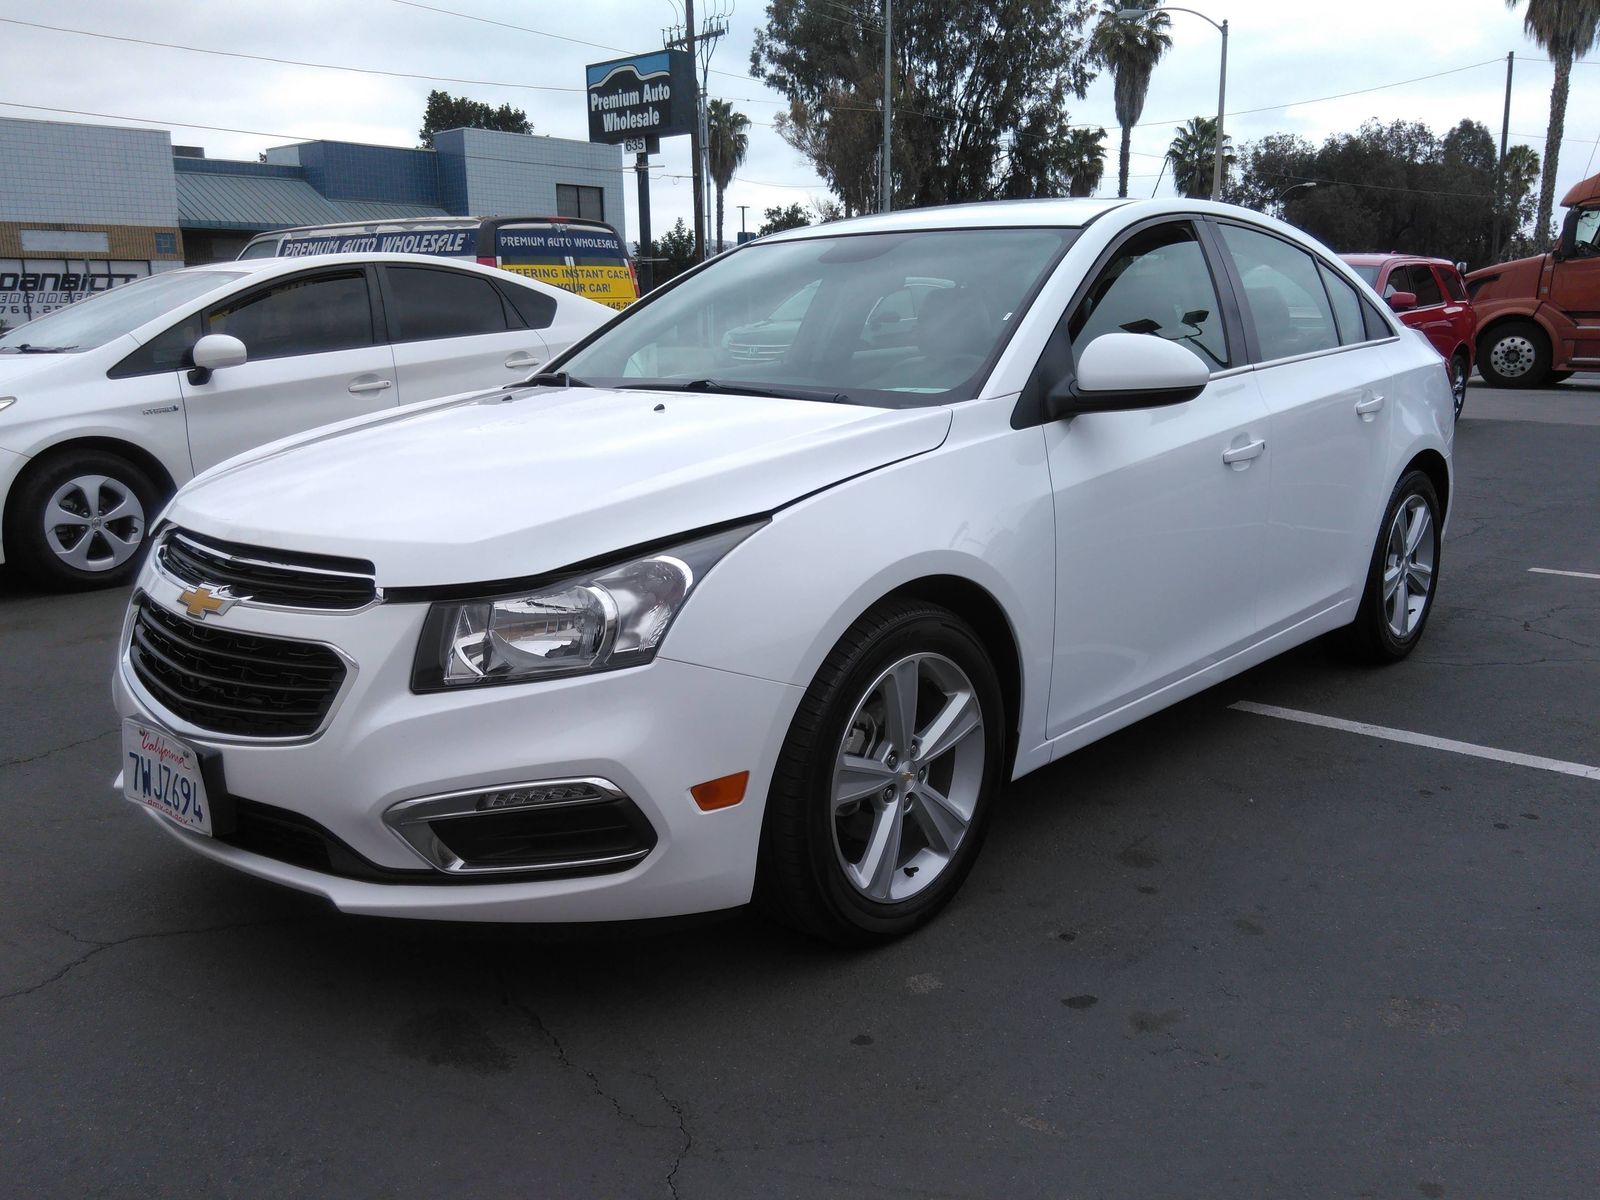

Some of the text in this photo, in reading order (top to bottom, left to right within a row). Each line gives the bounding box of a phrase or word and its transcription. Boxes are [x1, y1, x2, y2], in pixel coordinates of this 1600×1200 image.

[591, 83, 671, 112] Premium Auto
[603, 106, 660, 133] Wholesale
[625, 140, 645, 152] 635
[284, 233, 466, 257] PREMIUM AUTO WHOLESALE
[501, 236, 619, 249] PREMIUM AUTO WHOLESALE
[561, 269, 606, 279] INSTANT
[607, 270, 630, 280] CASH
[588, 283, 612, 293] CAR!
[142, 732, 191, 771] California
[129, 752, 203, 822] 7WJZ694
